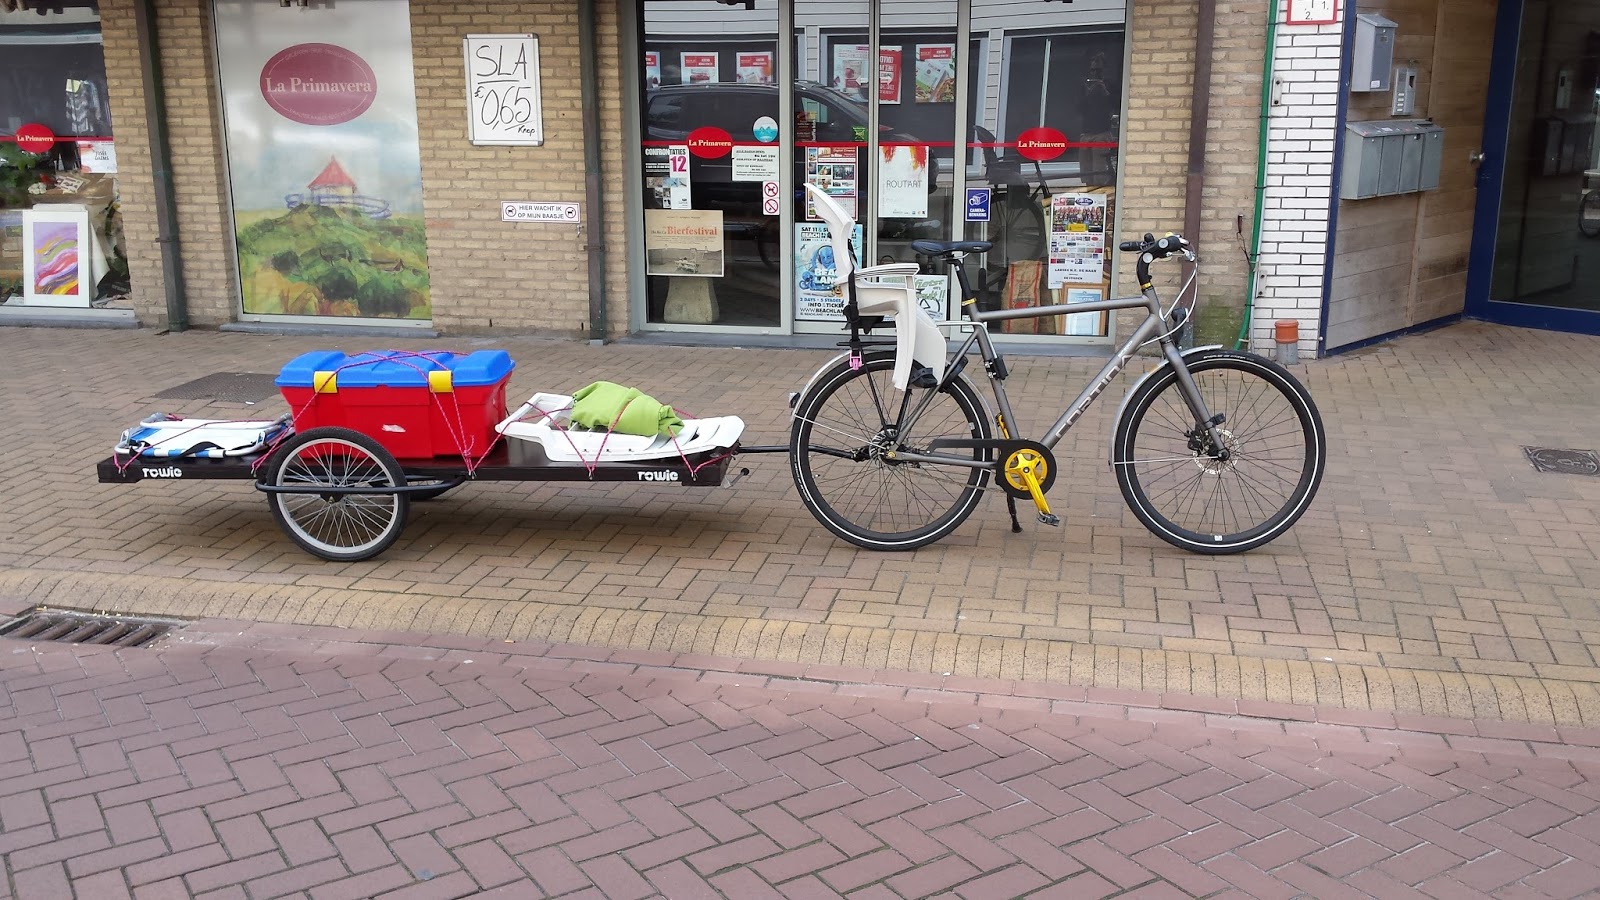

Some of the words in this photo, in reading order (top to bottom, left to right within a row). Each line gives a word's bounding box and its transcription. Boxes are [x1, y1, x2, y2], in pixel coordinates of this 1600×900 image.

[476, 43, 527, 80] SLA
[265, 77, 286, 93] La
[289, 77, 372, 93] Primavera
[17, 134, 25, 142] La
[25, 134, 54, 142] Primavera
[1018, 140, 1028, 148] La
[1029, 140, 1066, 148] Primavera
[645, 148, 686, 156] CONFRONTATIES
[670, 155, 687, 172] 12
[518, 204, 534, 212] HIER
[534, 204, 554, 212] WACHT
[554, 204, 563, 212] IK
[517, 211, 527, 220] OP
[527, 212, 542, 220] MIJN
[542, 212, 565, 220] BAASJE
[667, 226, 718, 236] Bierfestival
[142, 466, 183, 478] rowie
[637, 469, 679, 481] rowie
